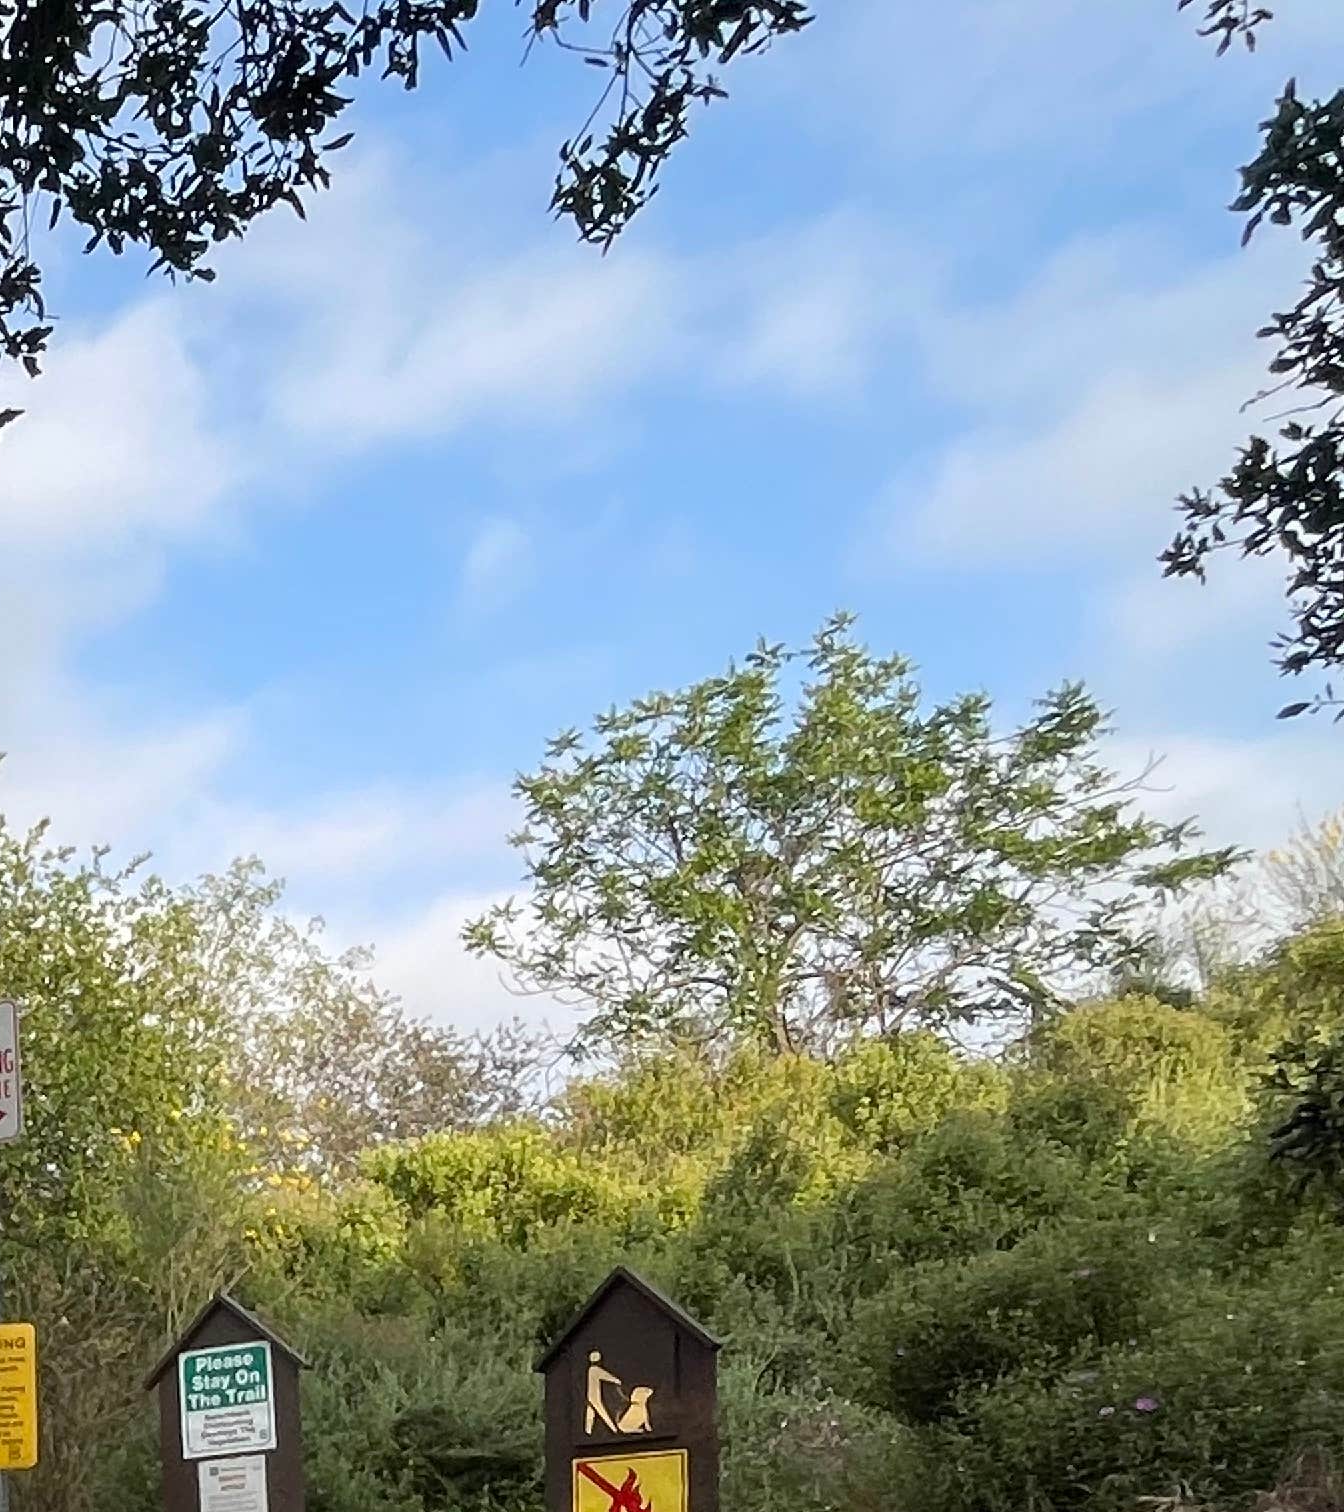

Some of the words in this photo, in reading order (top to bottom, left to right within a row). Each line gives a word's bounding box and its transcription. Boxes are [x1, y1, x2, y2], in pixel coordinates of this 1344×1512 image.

[196, 1353, 254, 1374] Please
[192, 1374, 231, 1392] Stay
[235, 1368, 261, 1386] On
[188, 1393, 222, 1410] The
[225, 1384, 267, 1404] Trail
